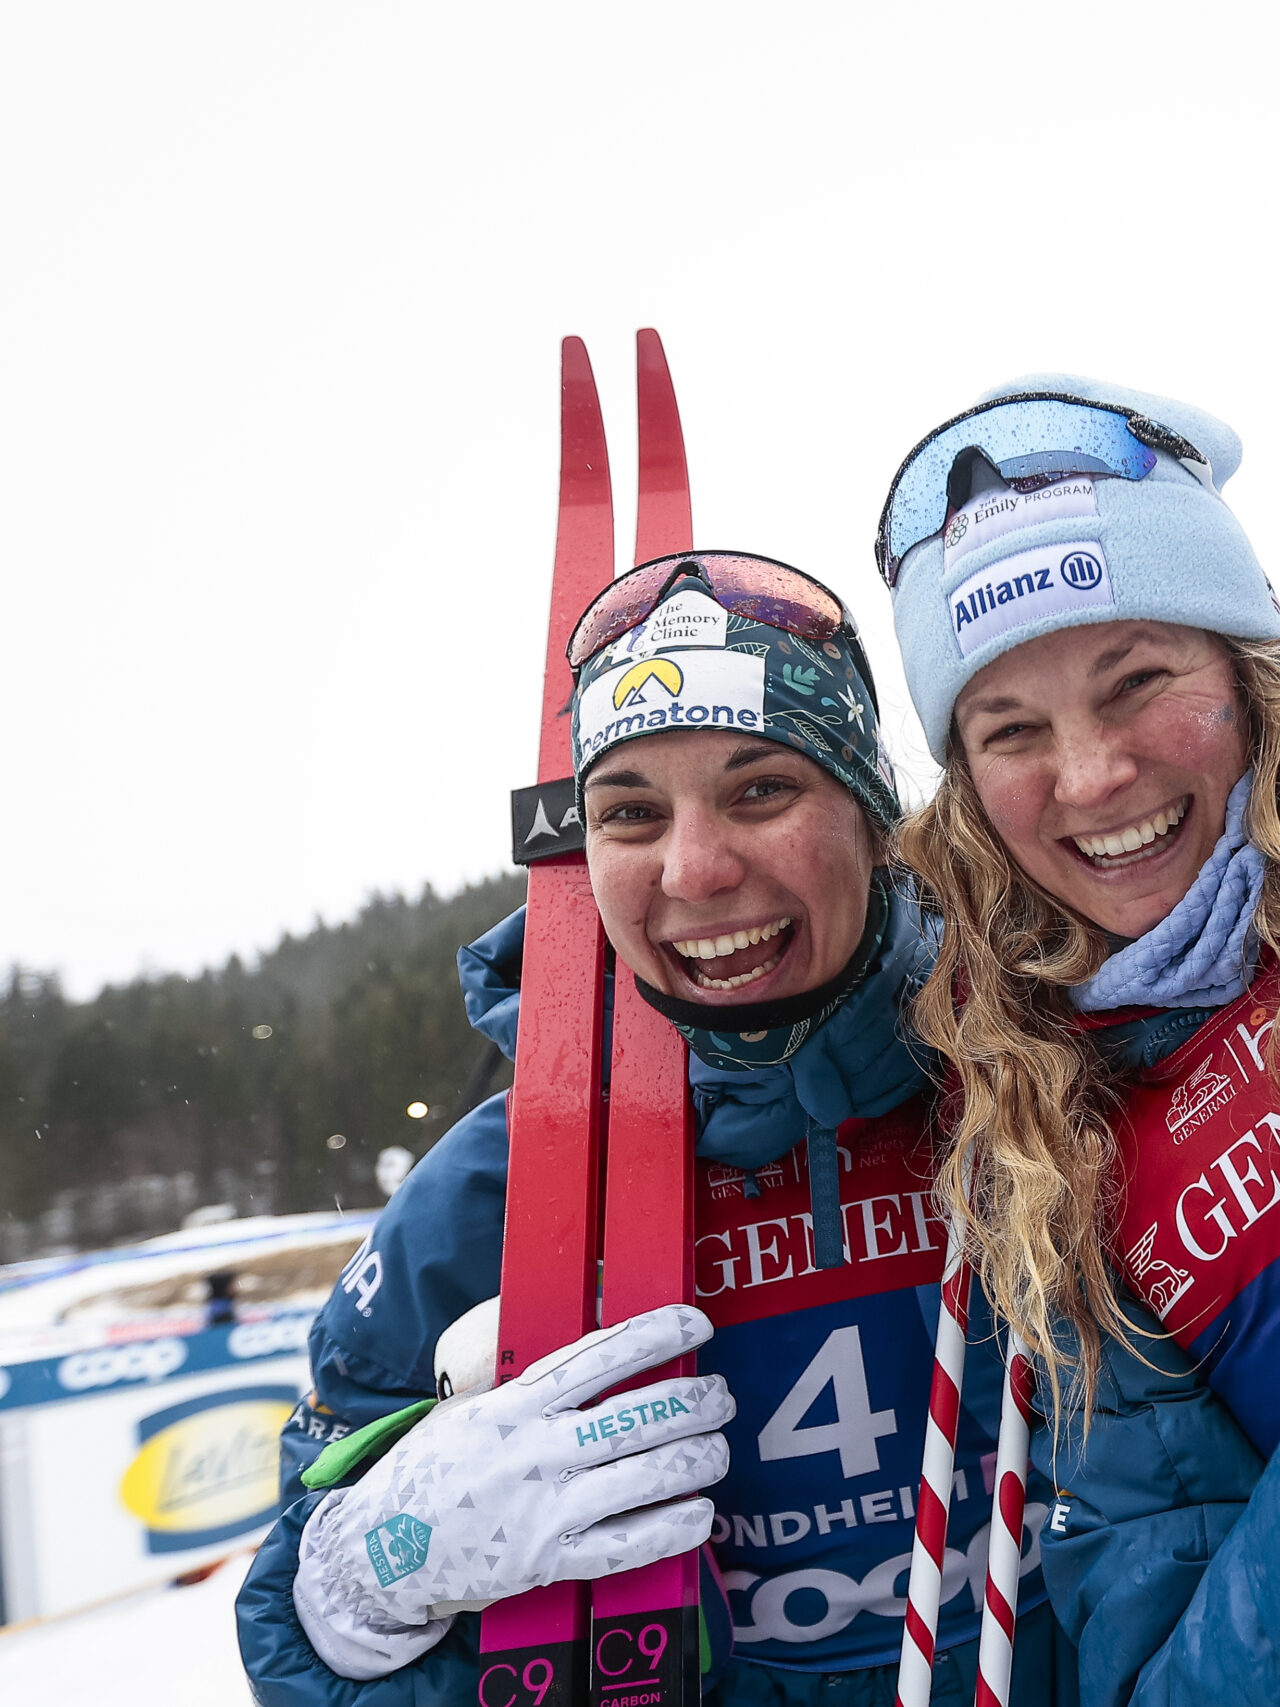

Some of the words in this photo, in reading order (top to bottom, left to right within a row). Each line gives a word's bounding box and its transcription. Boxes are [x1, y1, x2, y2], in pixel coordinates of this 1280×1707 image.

[974, 496, 1020, 524] Emily
[1024, 484, 1094, 504] PROGRAM
[979, 496, 998, 509] THE
[652, 613, 721, 631] Memory
[657, 601, 684, 617] The
[954, 567, 1055, 634] Allianz
[650, 626, 699, 643] Clinic
[1172, 1084, 1238, 1146] GENERALI
[859, 1153, 887, 1168] Net
[575, 1396, 691, 1448] HESTRA
[757, 1326, 898, 1478] 4
[369, 1533, 393, 1584] HESTRA
[595, 1623, 668, 1677] C9
[478, 1657, 554, 1707] C9
